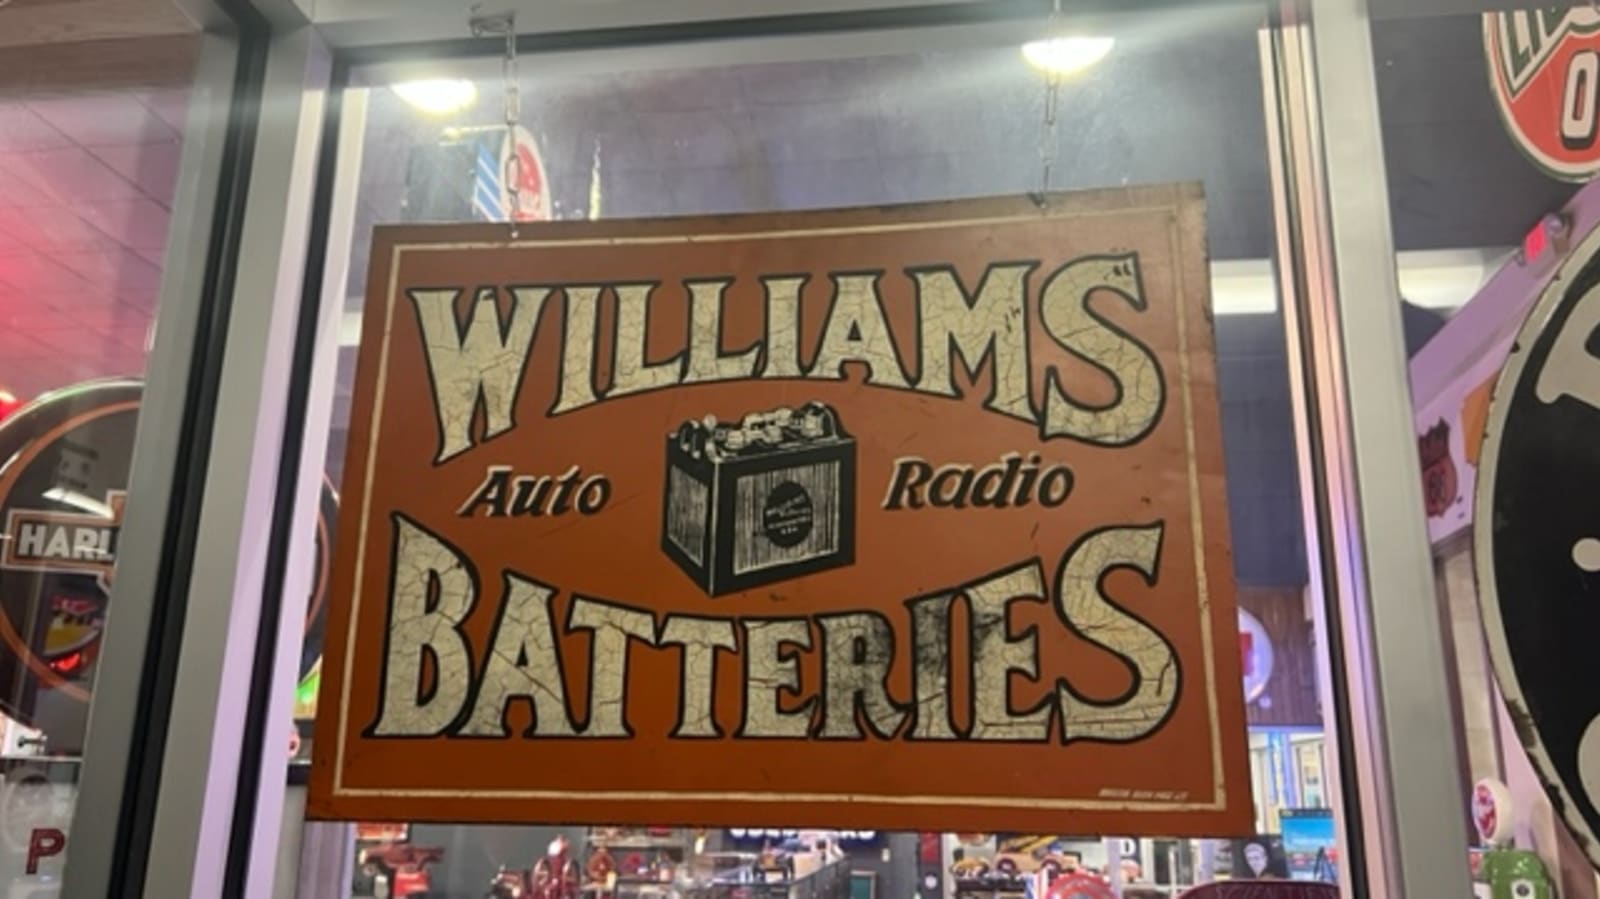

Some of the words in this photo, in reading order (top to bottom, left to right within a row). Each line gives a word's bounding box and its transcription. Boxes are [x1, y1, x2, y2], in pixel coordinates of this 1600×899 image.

[406, 251, 1166, 466] WILLIAMS
[457, 464, 612, 518] Auto
[881, 453, 1075, 511] Radio
[363, 511, 1181, 744] BATTERIES
